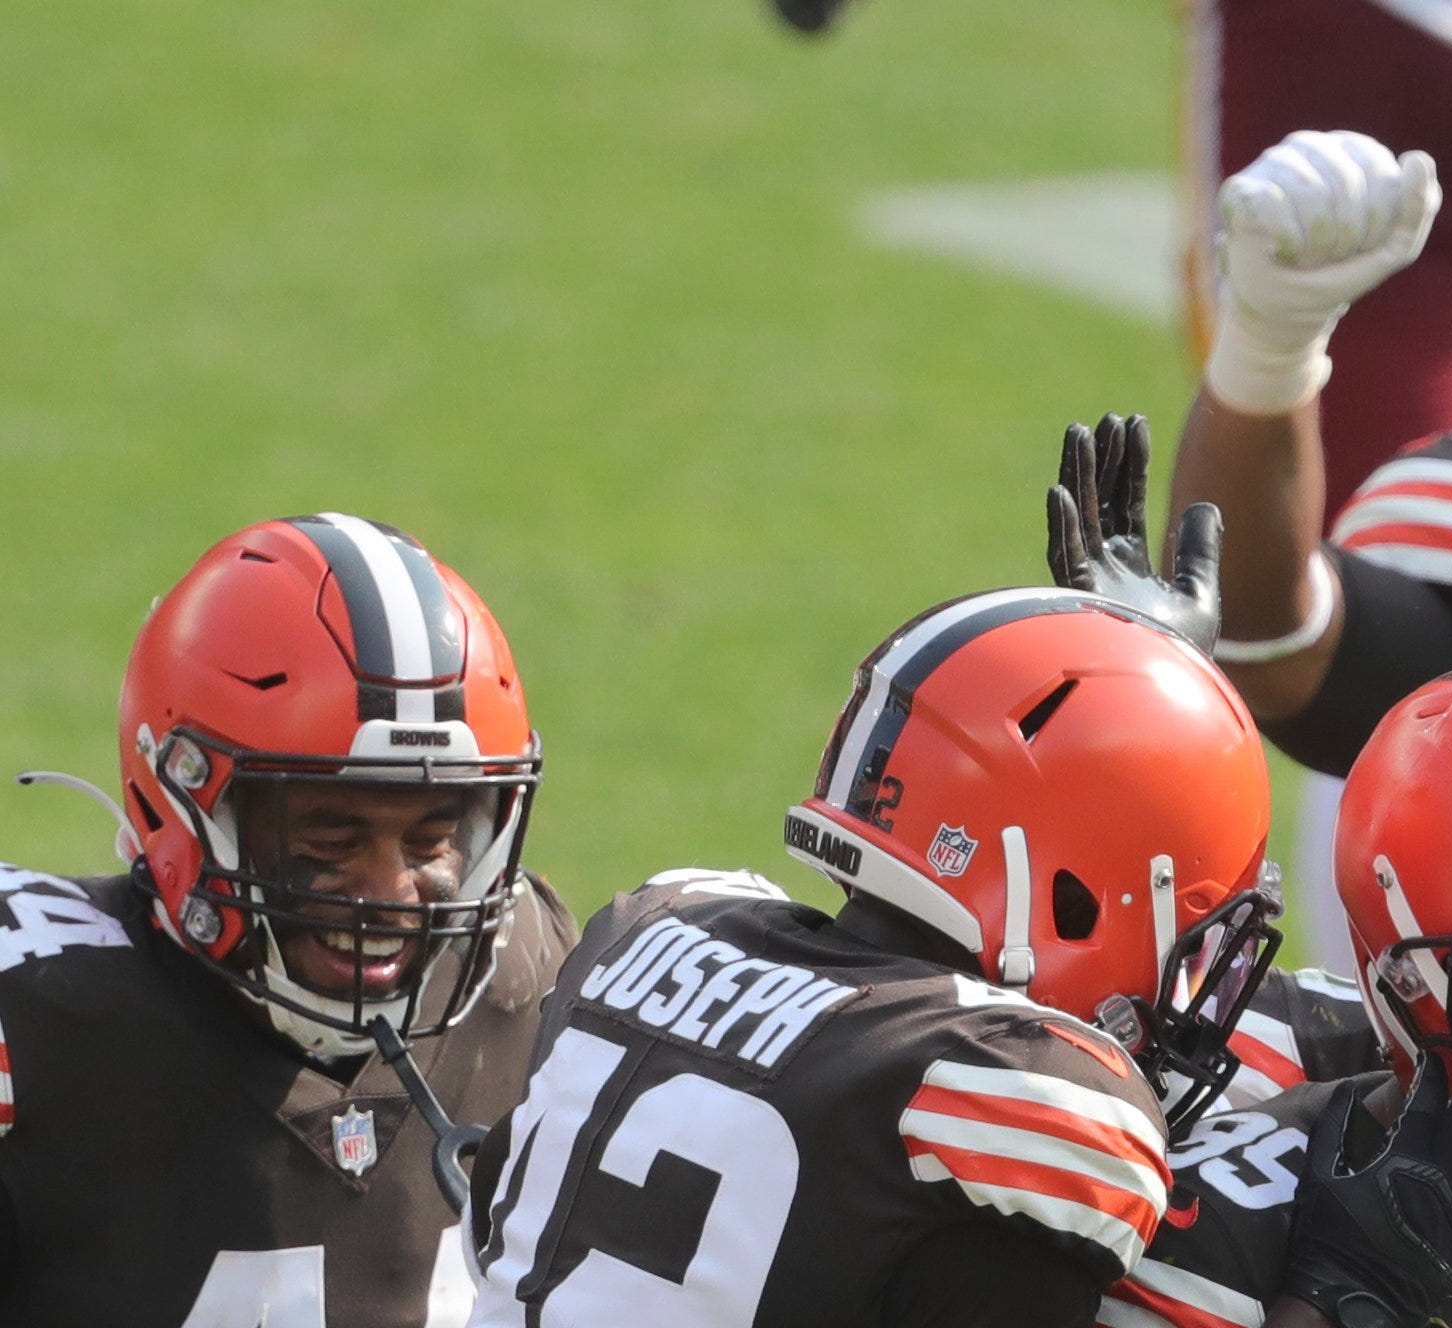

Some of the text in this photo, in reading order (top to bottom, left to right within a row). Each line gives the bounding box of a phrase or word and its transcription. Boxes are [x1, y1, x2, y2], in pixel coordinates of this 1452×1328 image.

[390, 729, 450, 746] BROWNS
[931, 842, 962, 872] NFL
[580, 916, 858, 1068] JOSEPH
[1166, 1111, 1310, 1210] 95
